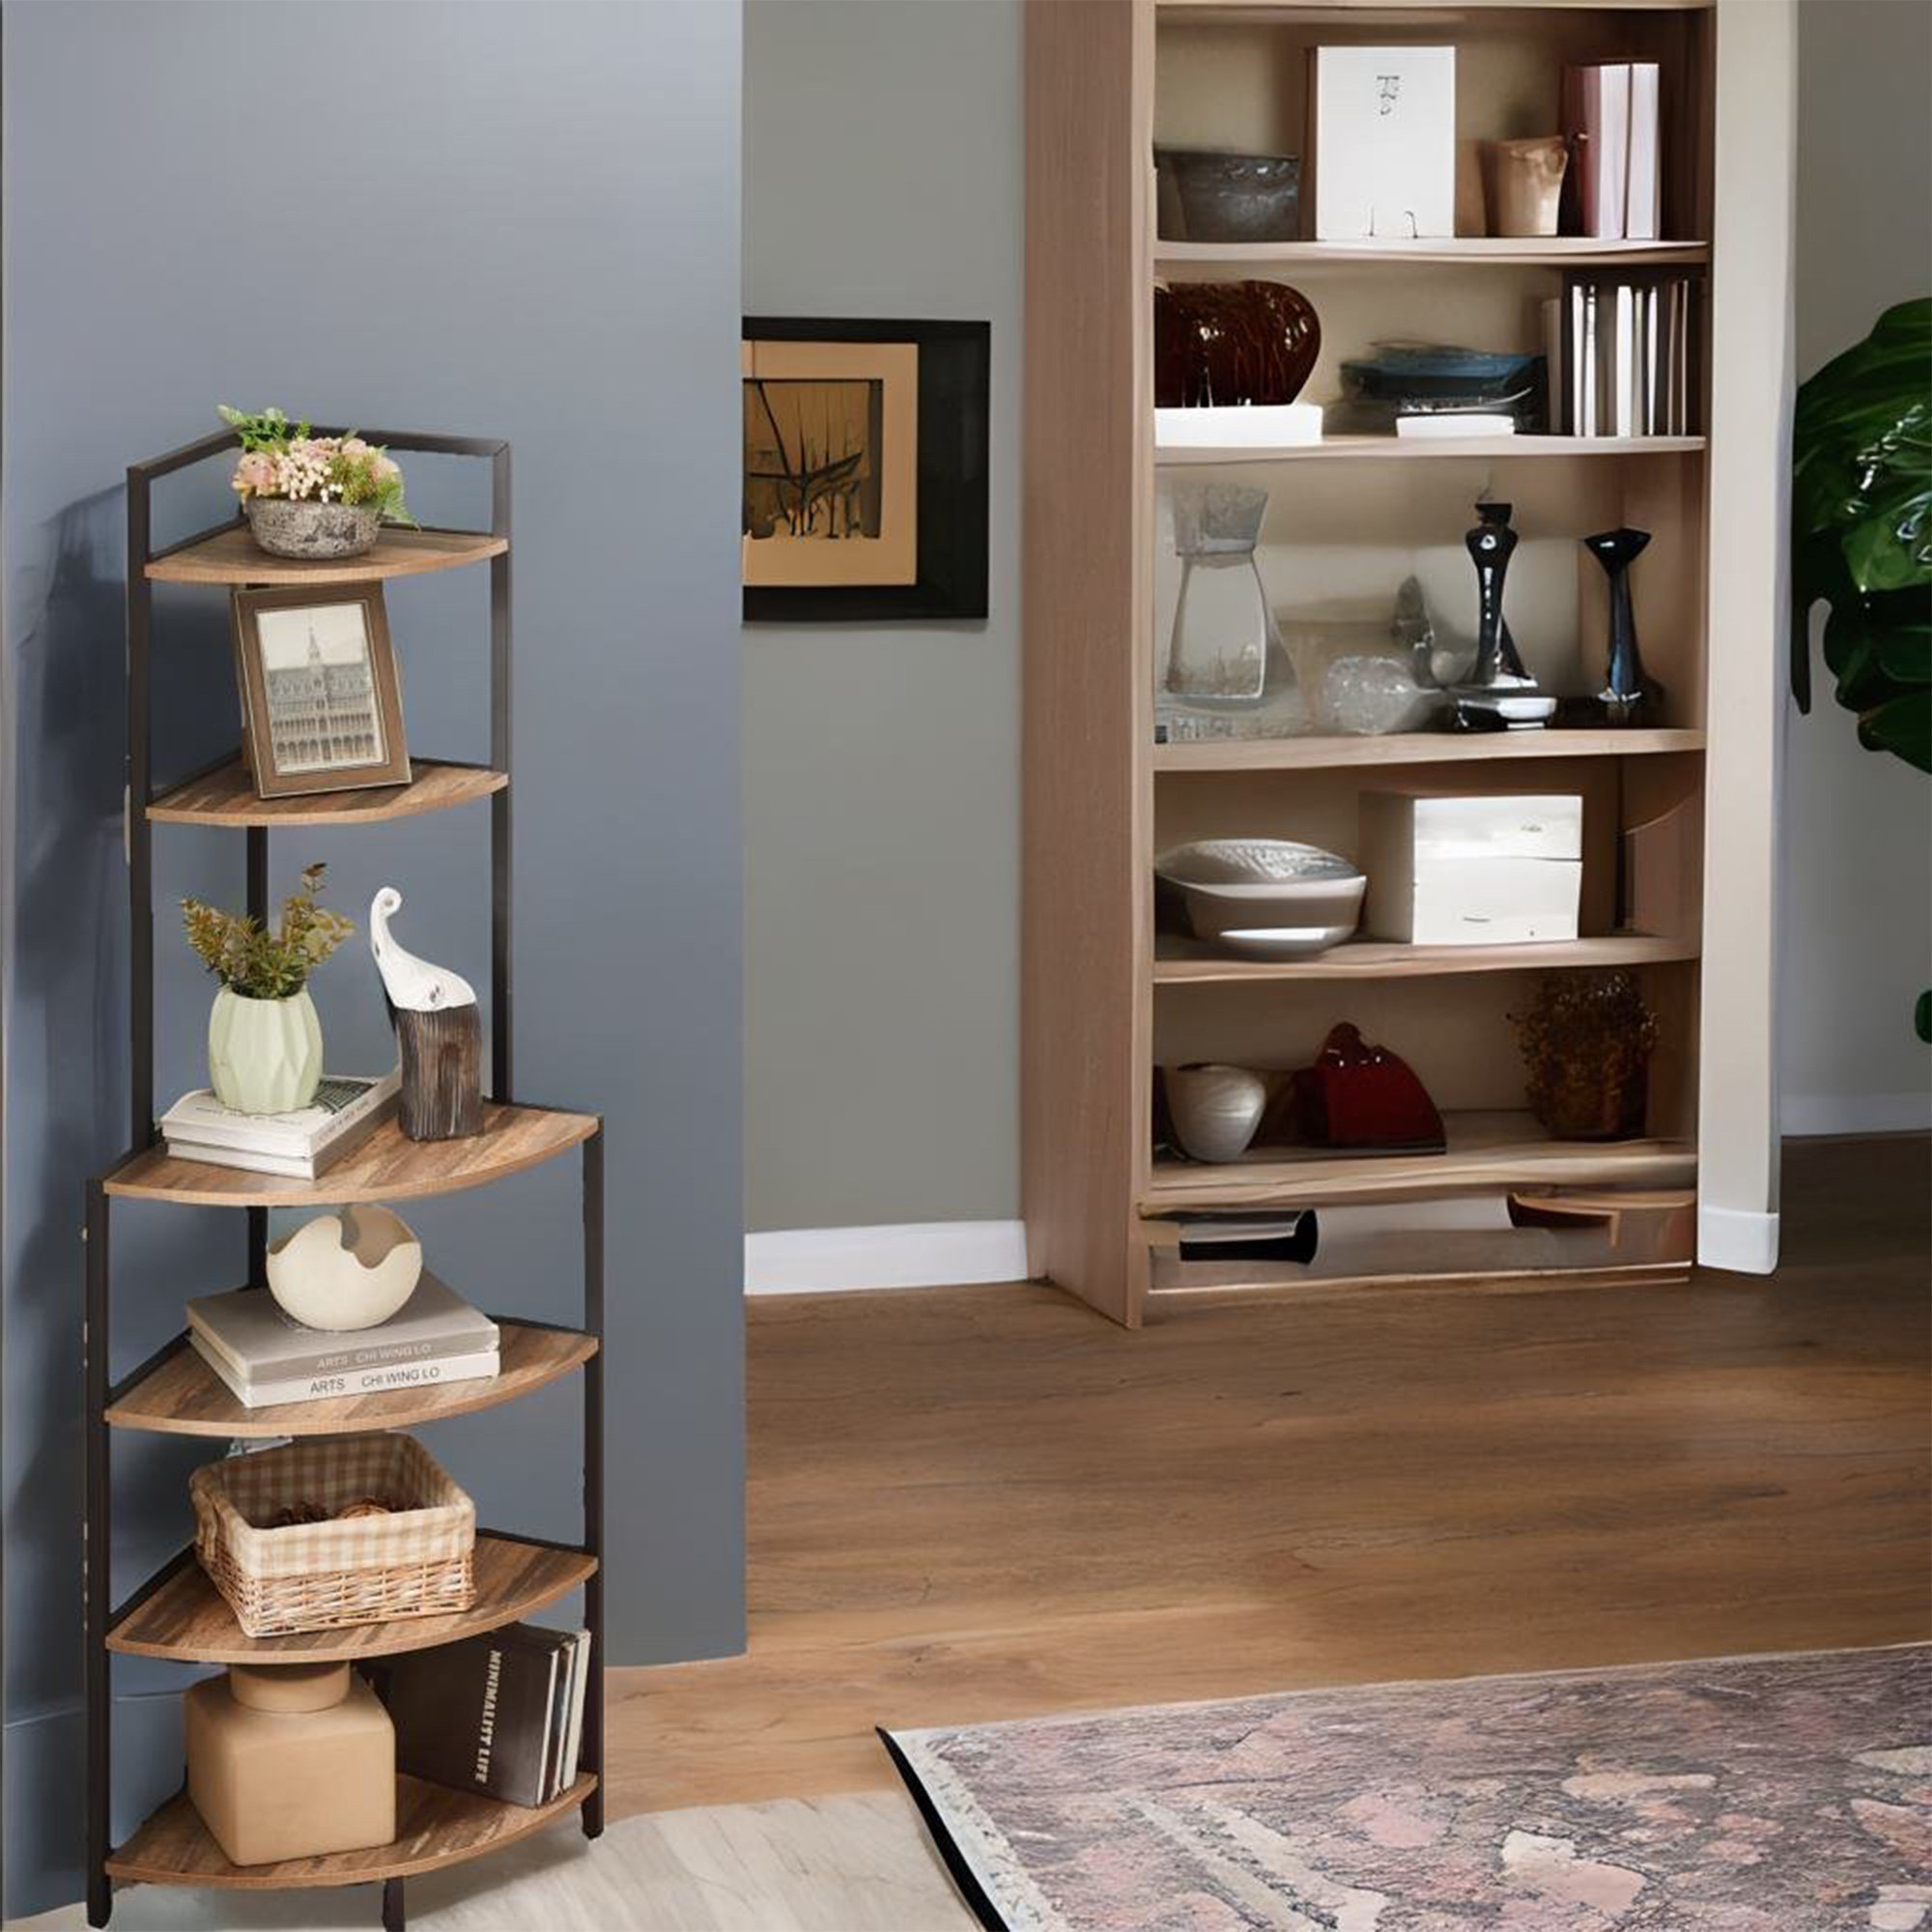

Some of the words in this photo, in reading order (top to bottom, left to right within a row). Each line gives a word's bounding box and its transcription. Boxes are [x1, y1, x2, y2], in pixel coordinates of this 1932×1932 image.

[310, 1378, 346, 1393] ARTS
[361, 1375, 384, 1387] CHI
[385, 1369, 420, 1384] WING
[421, 1366, 440, 1378] LO
[474, 1748, 491, 1783] LIFE
